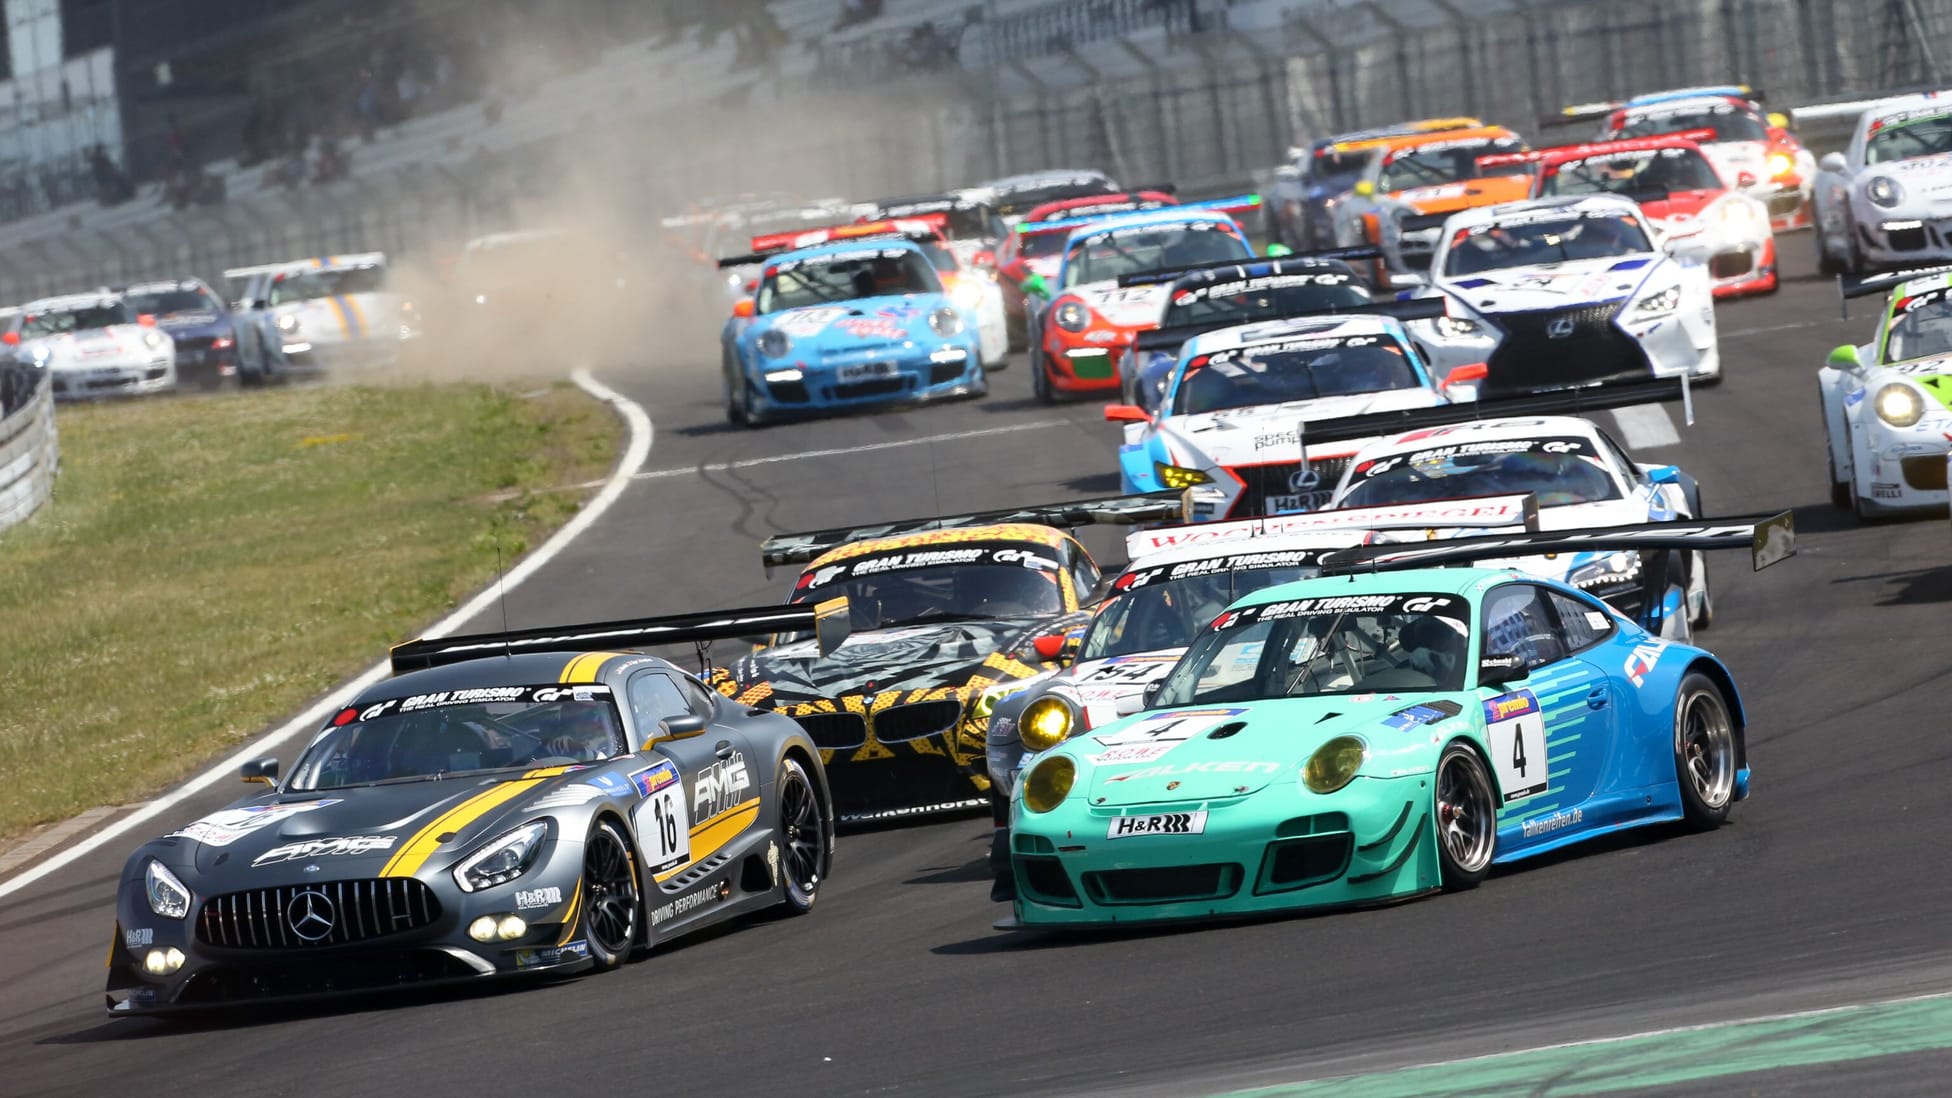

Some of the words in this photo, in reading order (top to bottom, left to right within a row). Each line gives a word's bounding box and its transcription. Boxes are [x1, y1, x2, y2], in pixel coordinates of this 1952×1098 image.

[853, 556, 902, 571] GRAN
[904, 549, 984, 565] TURISMO
[1171, 558, 1224, 576] GRAN
[1225, 551, 1306, 567] TURISMO
[1186, 570, 1210, 578] REAL
[1211, 565, 1247, 575] DRING
[1248, 561, 1300, 571] SIMULATOR
[1260, 600, 1315, 617] GRAN
[1316, 595, 1396, 611] TURISMO
[1273, 613, 1296, 621] REAL
[1297, 609, 1335, 618] DRIVING
[402, 693, 450, 708] GRAN
[451, 687, 525, 701] TURISMO
[1497, 695, 1529, 718] premio
[1145, 719, 1188, 737] 4
[1513, 722, 1527, 778] 4
[694, 760, 751, 812] AMG
[654, 793, 677, 857] 16
[1522, 807, 1583, 838] falkenreifen.de
[252, 836, 397, 867] AMG
[651, 905, 674, 926] DRIVING
[675, 885, 719, 918] PERFORMANCE
